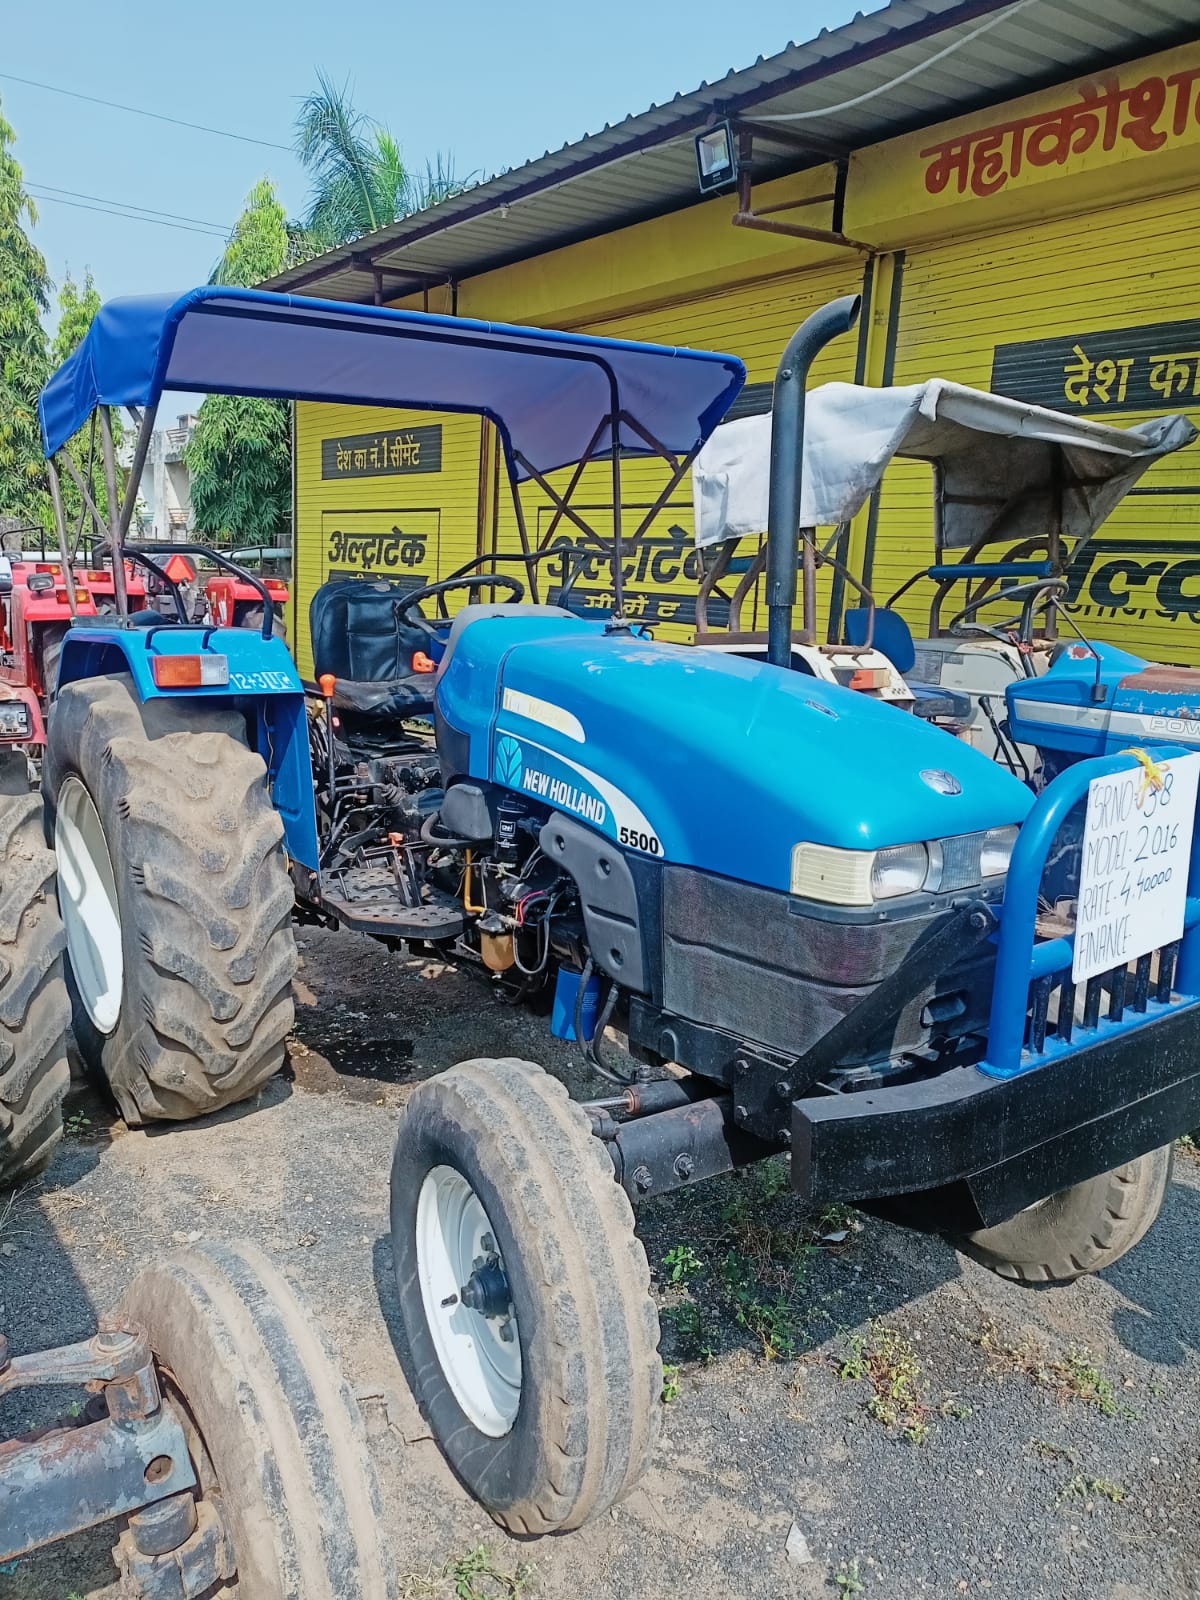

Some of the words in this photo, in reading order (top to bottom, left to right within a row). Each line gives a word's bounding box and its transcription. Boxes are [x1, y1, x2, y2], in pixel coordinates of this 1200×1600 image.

[920, 69, 1200, 197] महाकौश
[1063, 344, 1134, 407] देश
[336, 442, 352, 471] देश
[354, 448, 367, 469] का
[390, 433, 420, 467] सीमेंट
[328, 525, 427, 569] अल्ट्राटेक
[523, 768, 550, 797] NEW
[549, 783, 606, 825] HOLLAND
[619, 826, 659, 854] 5500
[1134, 823, 1179, 862] 2016
